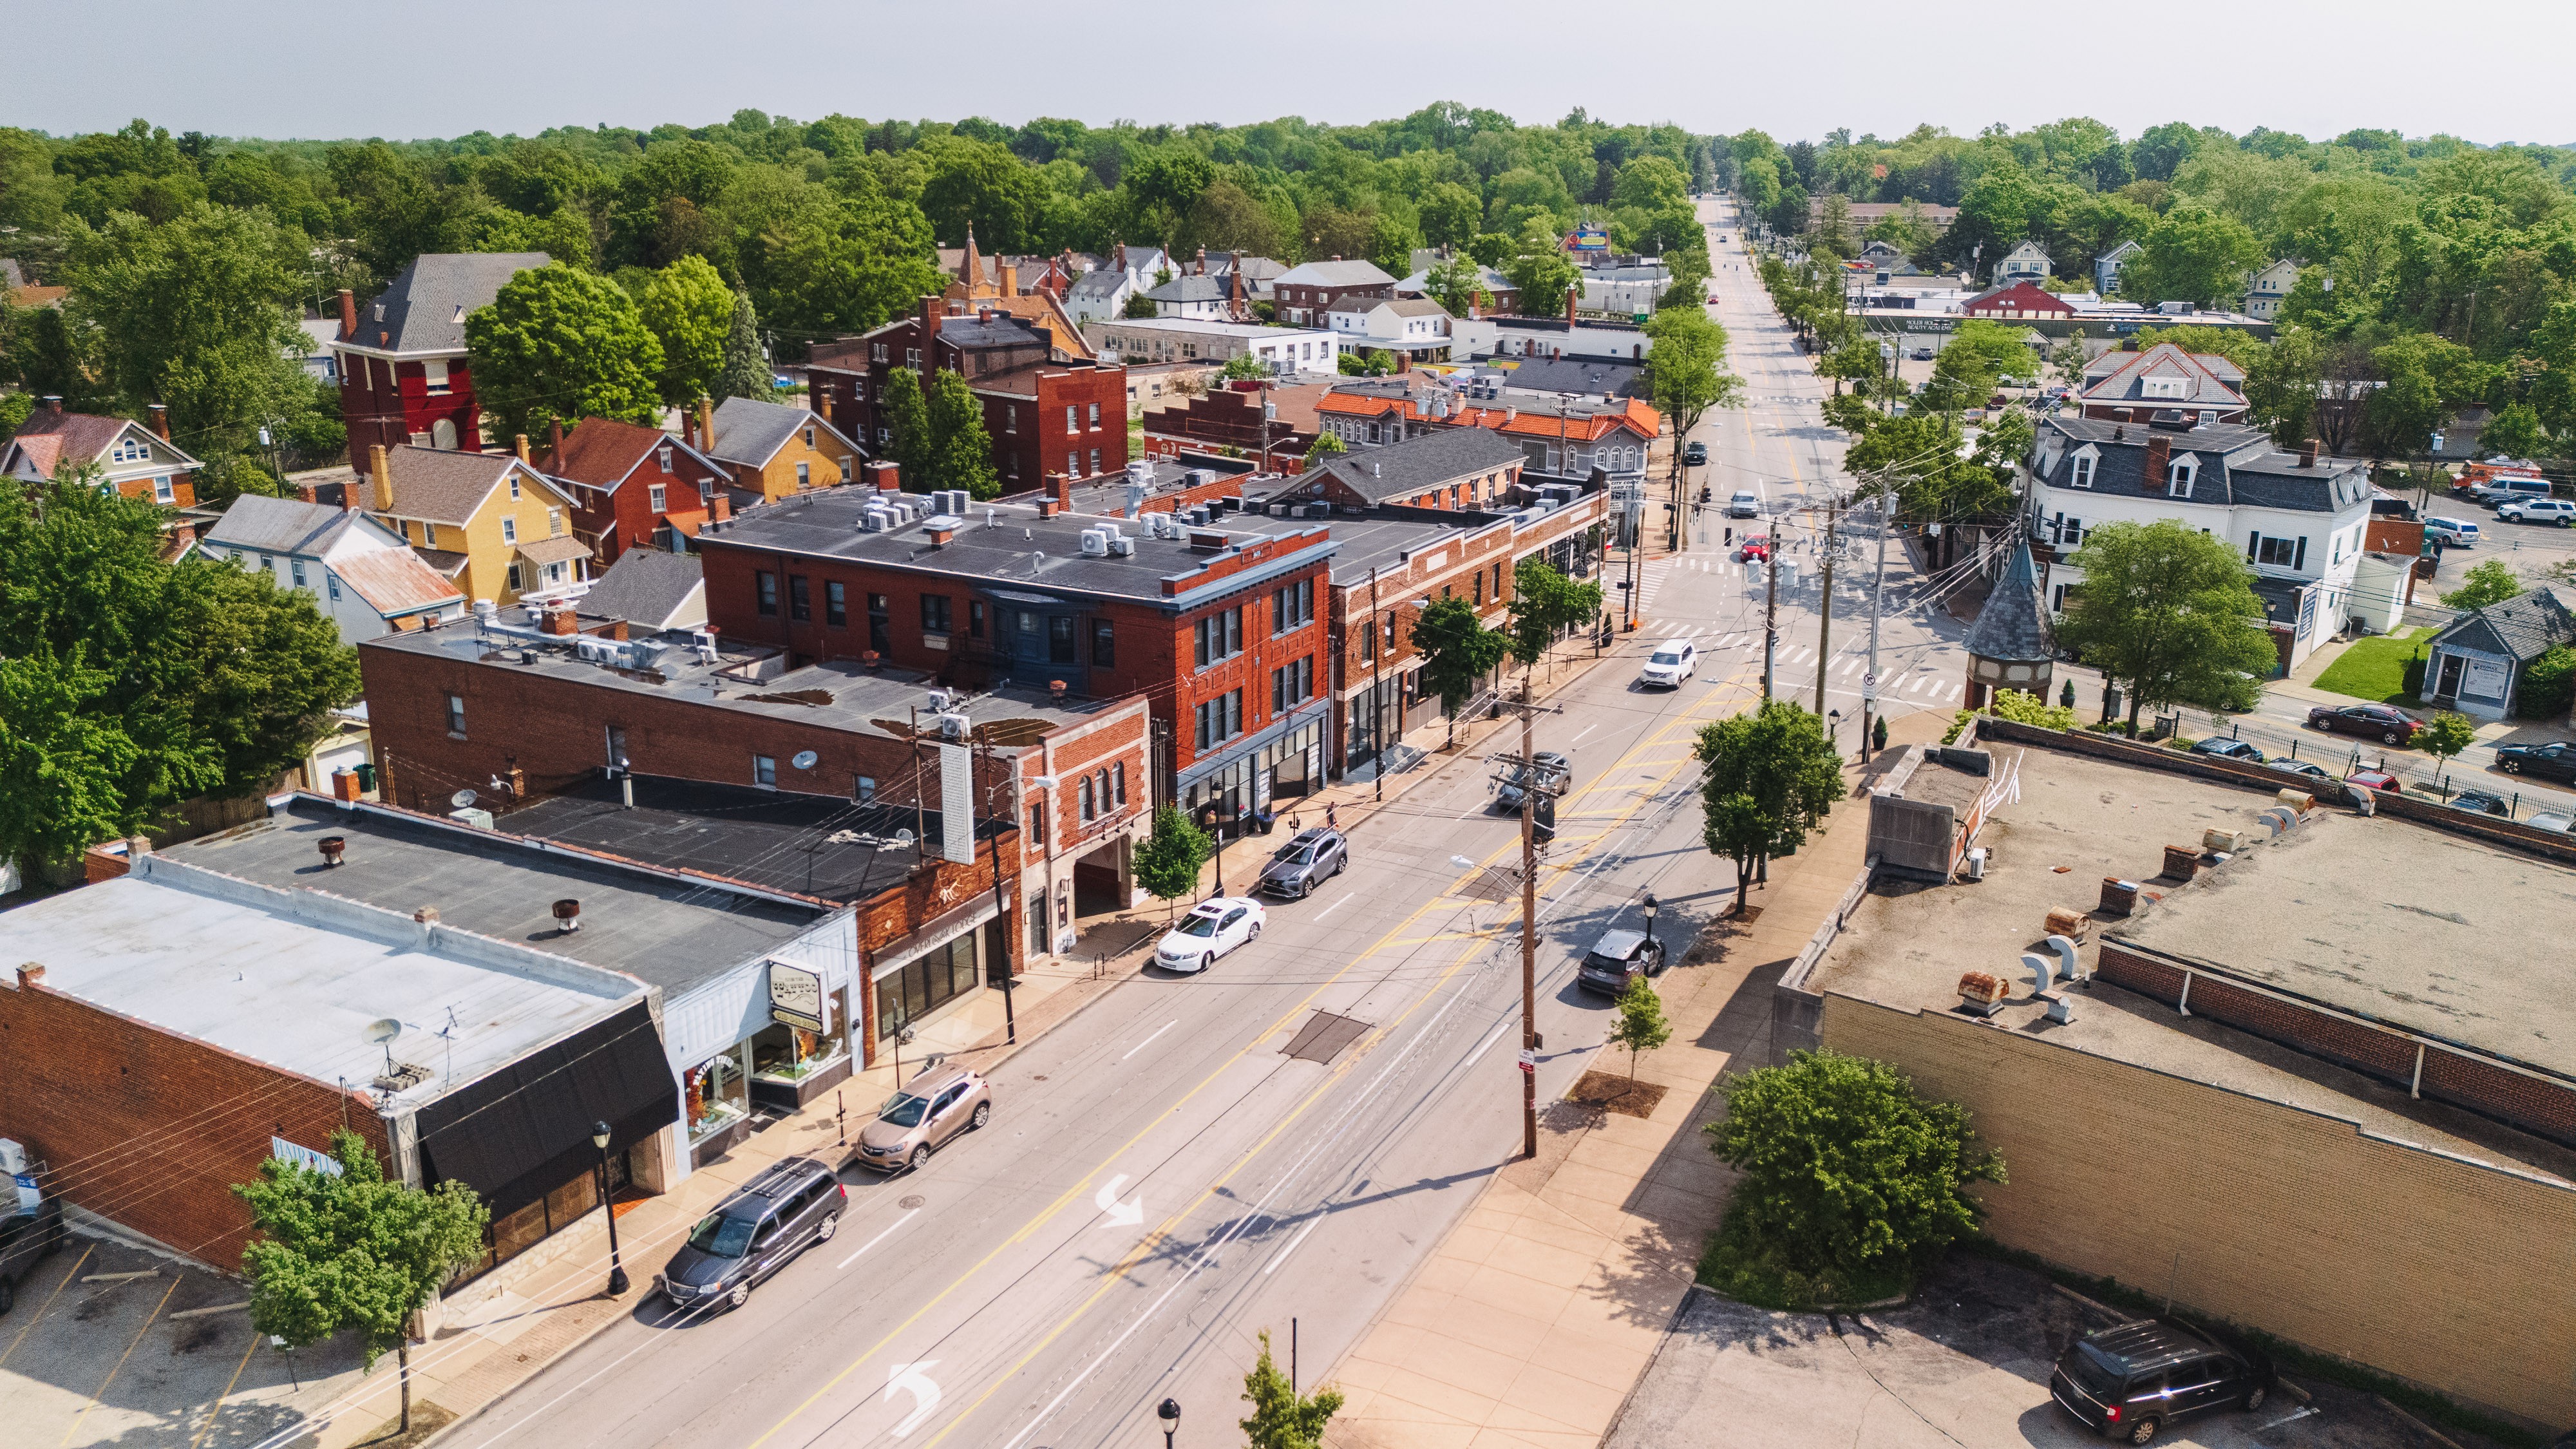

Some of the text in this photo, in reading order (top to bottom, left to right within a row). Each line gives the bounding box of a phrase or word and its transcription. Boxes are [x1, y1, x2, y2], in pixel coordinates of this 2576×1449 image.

[907, 913, 979, 958] OVERLOOK LODGE
[274, 1139, 306, 1164] HAIR
